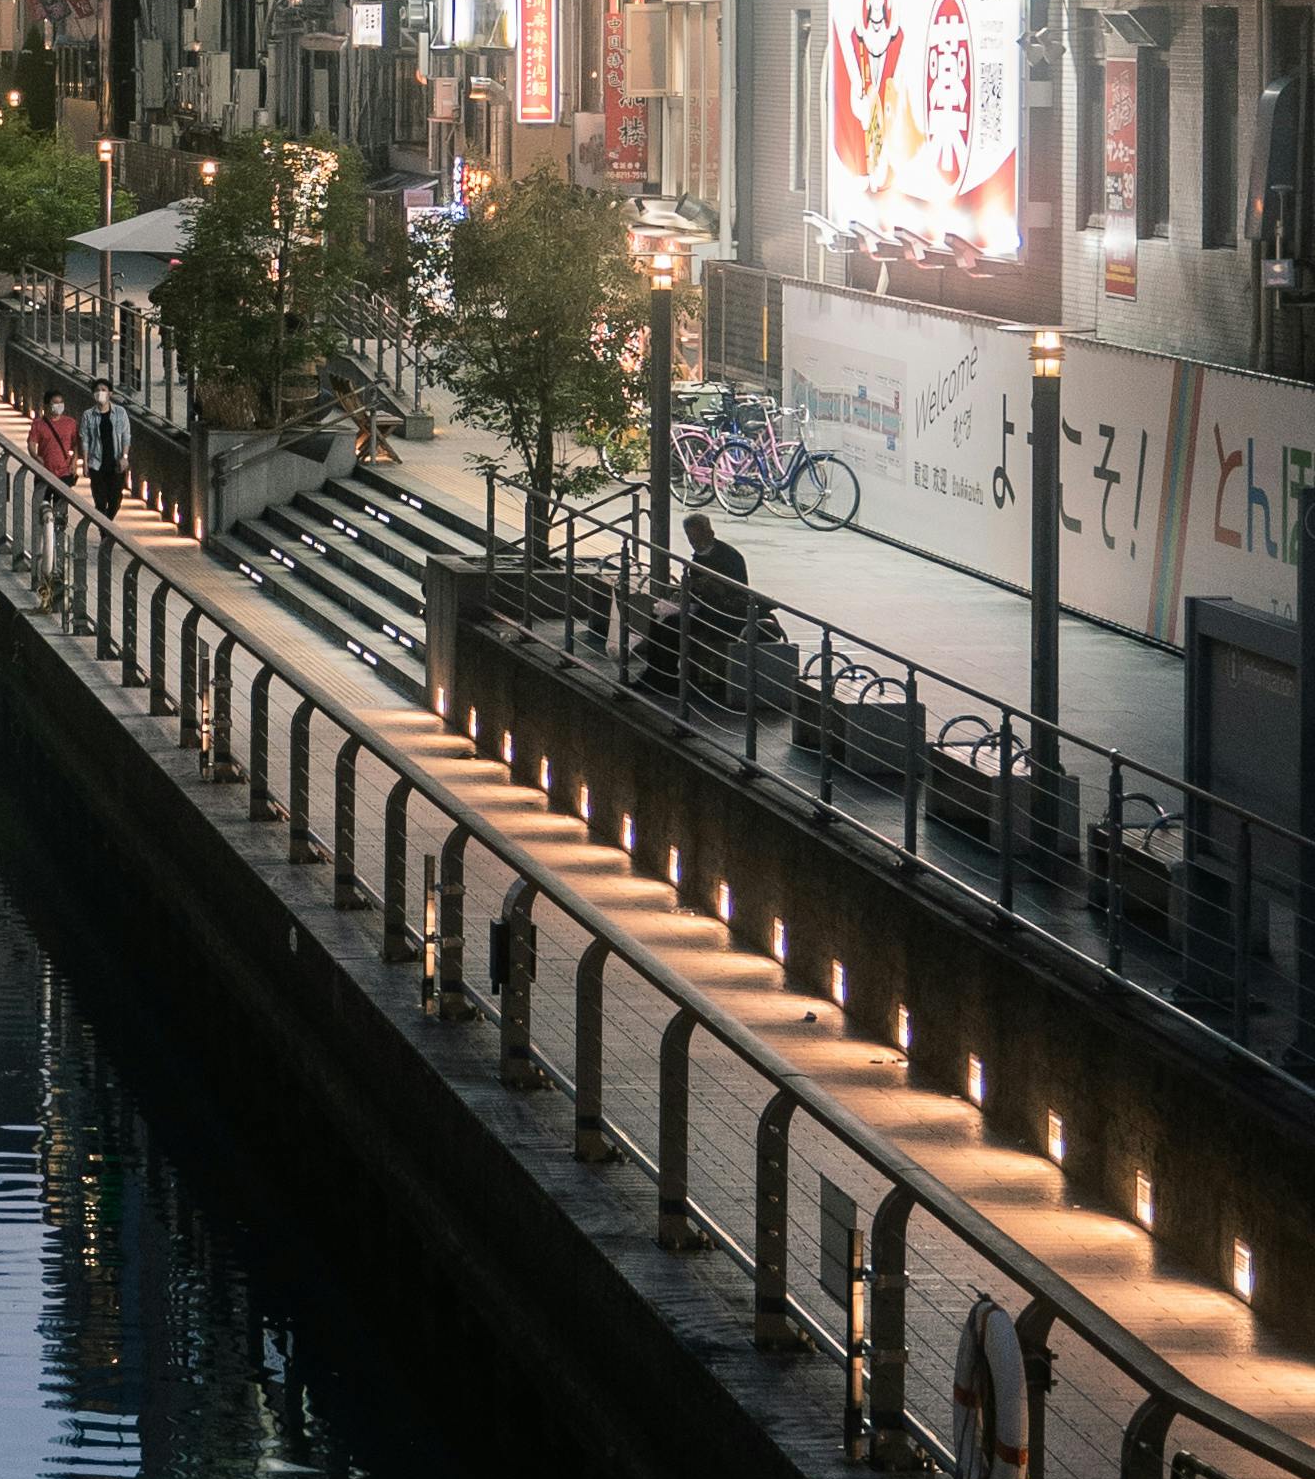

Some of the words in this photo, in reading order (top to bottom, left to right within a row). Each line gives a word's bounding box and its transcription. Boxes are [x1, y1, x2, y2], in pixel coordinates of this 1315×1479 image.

[914, 345, 979, 439] Welcome
[991, 392, 1149, 562] よこそ!
